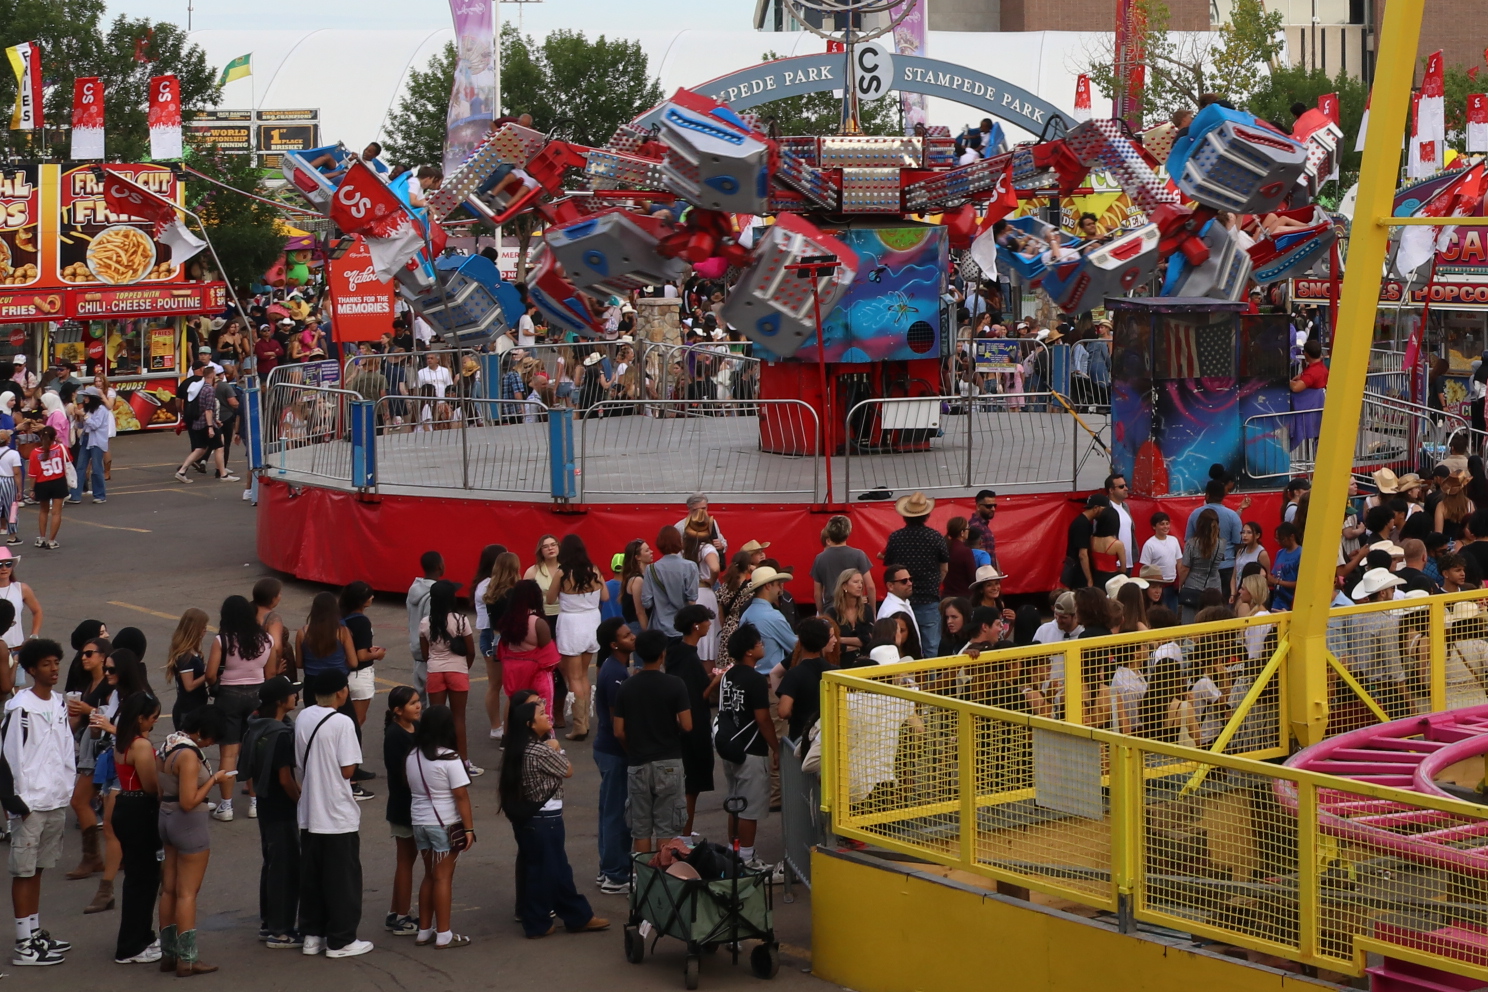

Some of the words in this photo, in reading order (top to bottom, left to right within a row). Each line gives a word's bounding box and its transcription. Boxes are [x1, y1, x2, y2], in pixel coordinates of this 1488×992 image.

[783, 65, 834, 86] PARK
[904, 66, 996, 101] STAMPEDE
[1000, 92, 1046, 125] PARK
[116, 291, 143, 299] TOPPED
[143, 290, 160, 298] WITH
[1, 305, 36, 316] FRIES
[78, 301, 106, 313] CHILI
[111, 299, 152, 312] CHEESE
[157, 297, 201, 309] POUTINE
[338, 303, 390, 314] MEMORIES
[115, 382, 147, 391] SPUDS!
[40, 456, 63, 477] 50
